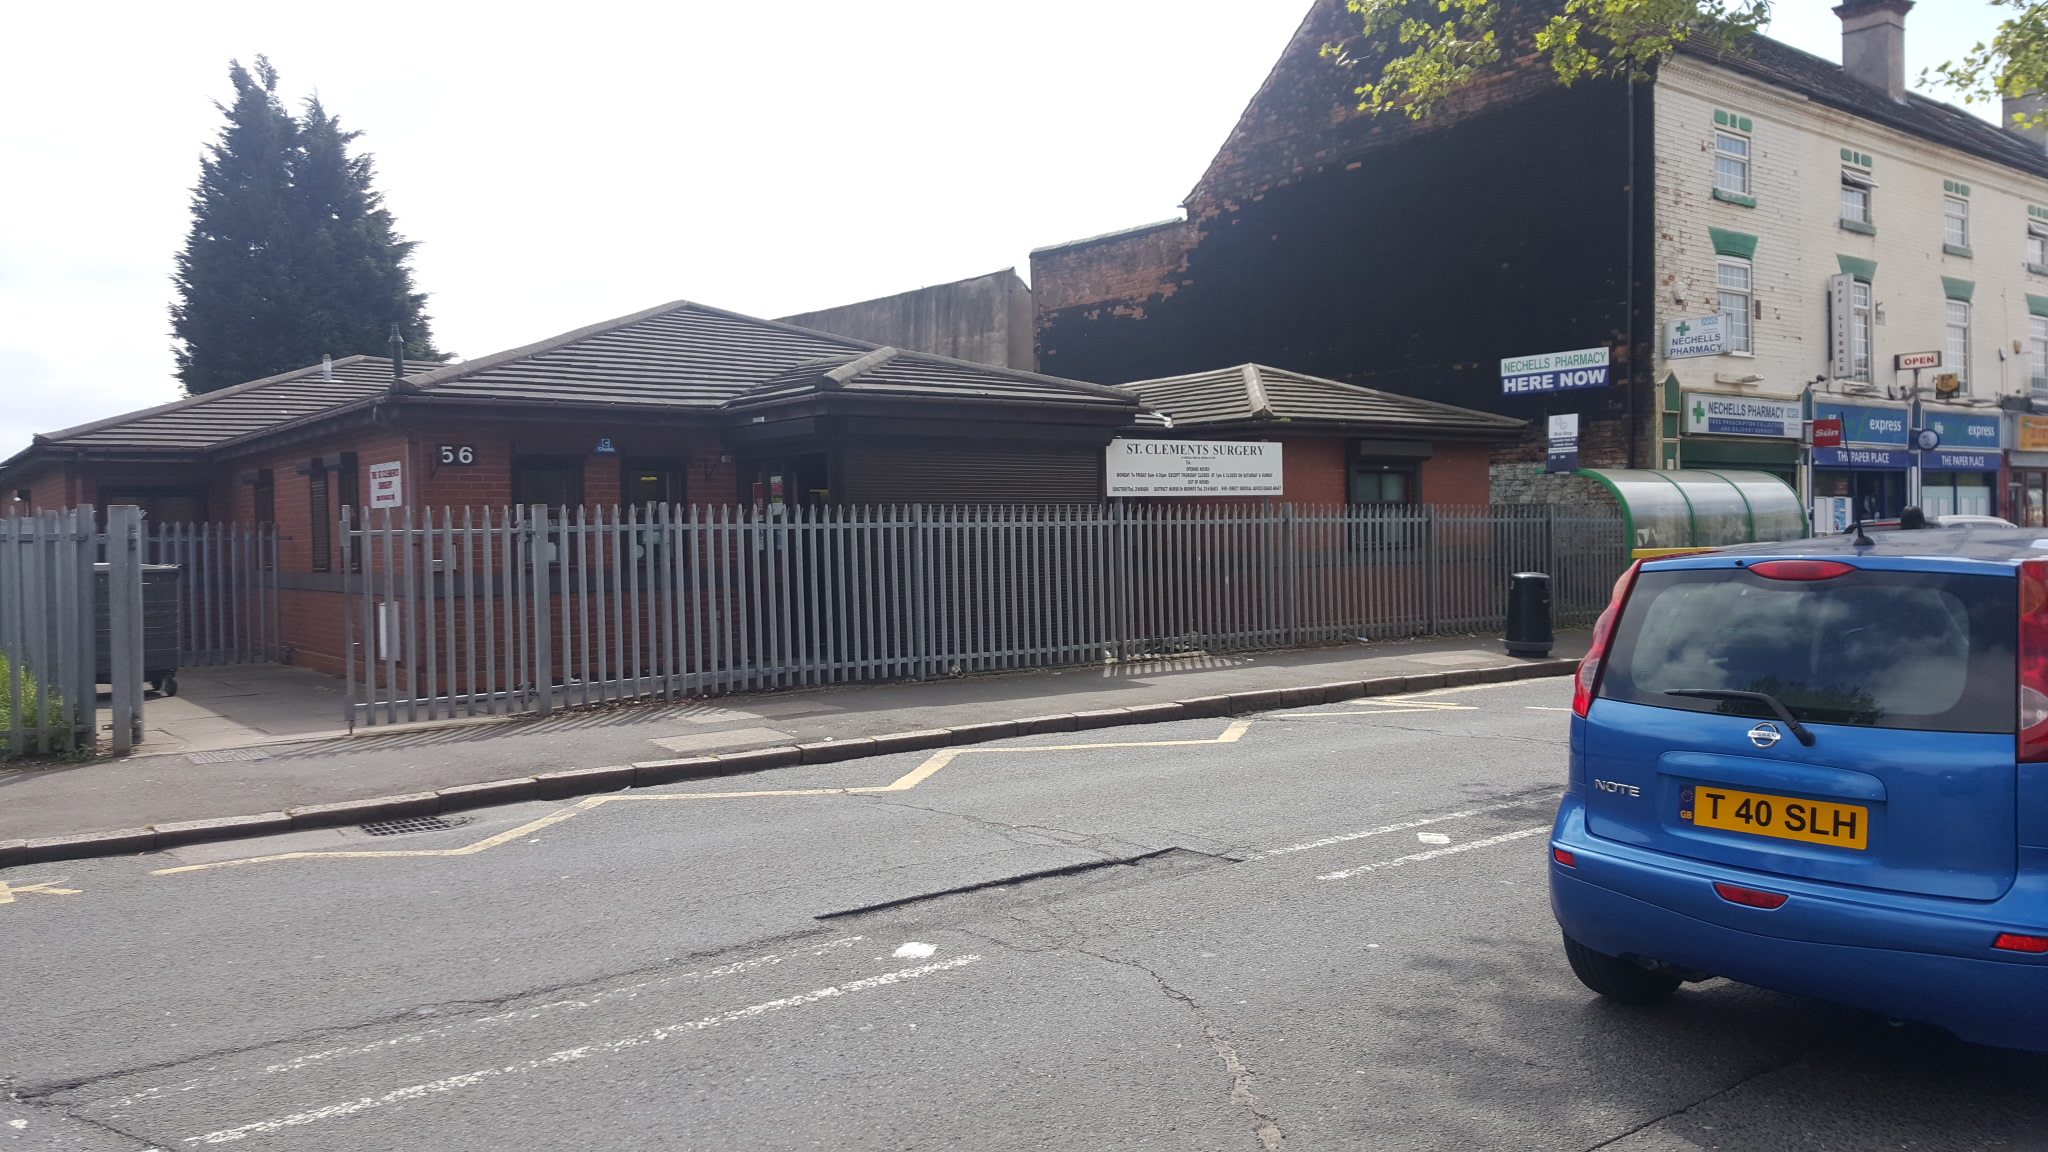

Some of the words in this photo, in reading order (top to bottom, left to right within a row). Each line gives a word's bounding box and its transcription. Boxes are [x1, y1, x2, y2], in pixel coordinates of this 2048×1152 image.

[1672, 333, 1721, 346] NECHELLS
[1670, 343, 1723, 356] PHARMACY
[1504, 357, 1550, 373] NECHELLS
[1555, 351, 1607, 368] PHARMACY
[1904, 355, 1935, 366] OPEN
[1503, 374, 1554, 393] HERE
[1560, 369, 1606, 388] NOW
[1708, 401, 1746, 417] NECHELLS
[1747, 404, 1785, 419] PHARMACY
[1756, 421, 1784, 429] COLLECTION
[1869, 419, 1902, 434] express
[1968, 425, 1995, 439] express
[441, 445, 474, 464] 56
[1126, 443, 1143, 455] ST.
[1145, 443, 1209, 455] CLEMENTS
[1213, 445, 1265, 456] SURGERY
[1851, 451, 1870, 463] PAPER
[1871, 452, 1890, 464] PLACE
[1941, 455, 1952, 466] THE
[1952, 455, 1969, 467] PAPER
[1969, 456, 1985, 467] PLACE
[1750, 731, 1777, 739] NISSAN
[1595, 779, 1641, 797] NOTE
[1680, 810, 1693, 820] GB
[1705, 792, 1726, 820] T
[1734, 798, 1773, 828] 40
[1784, 803, 1857, 840] SLH
